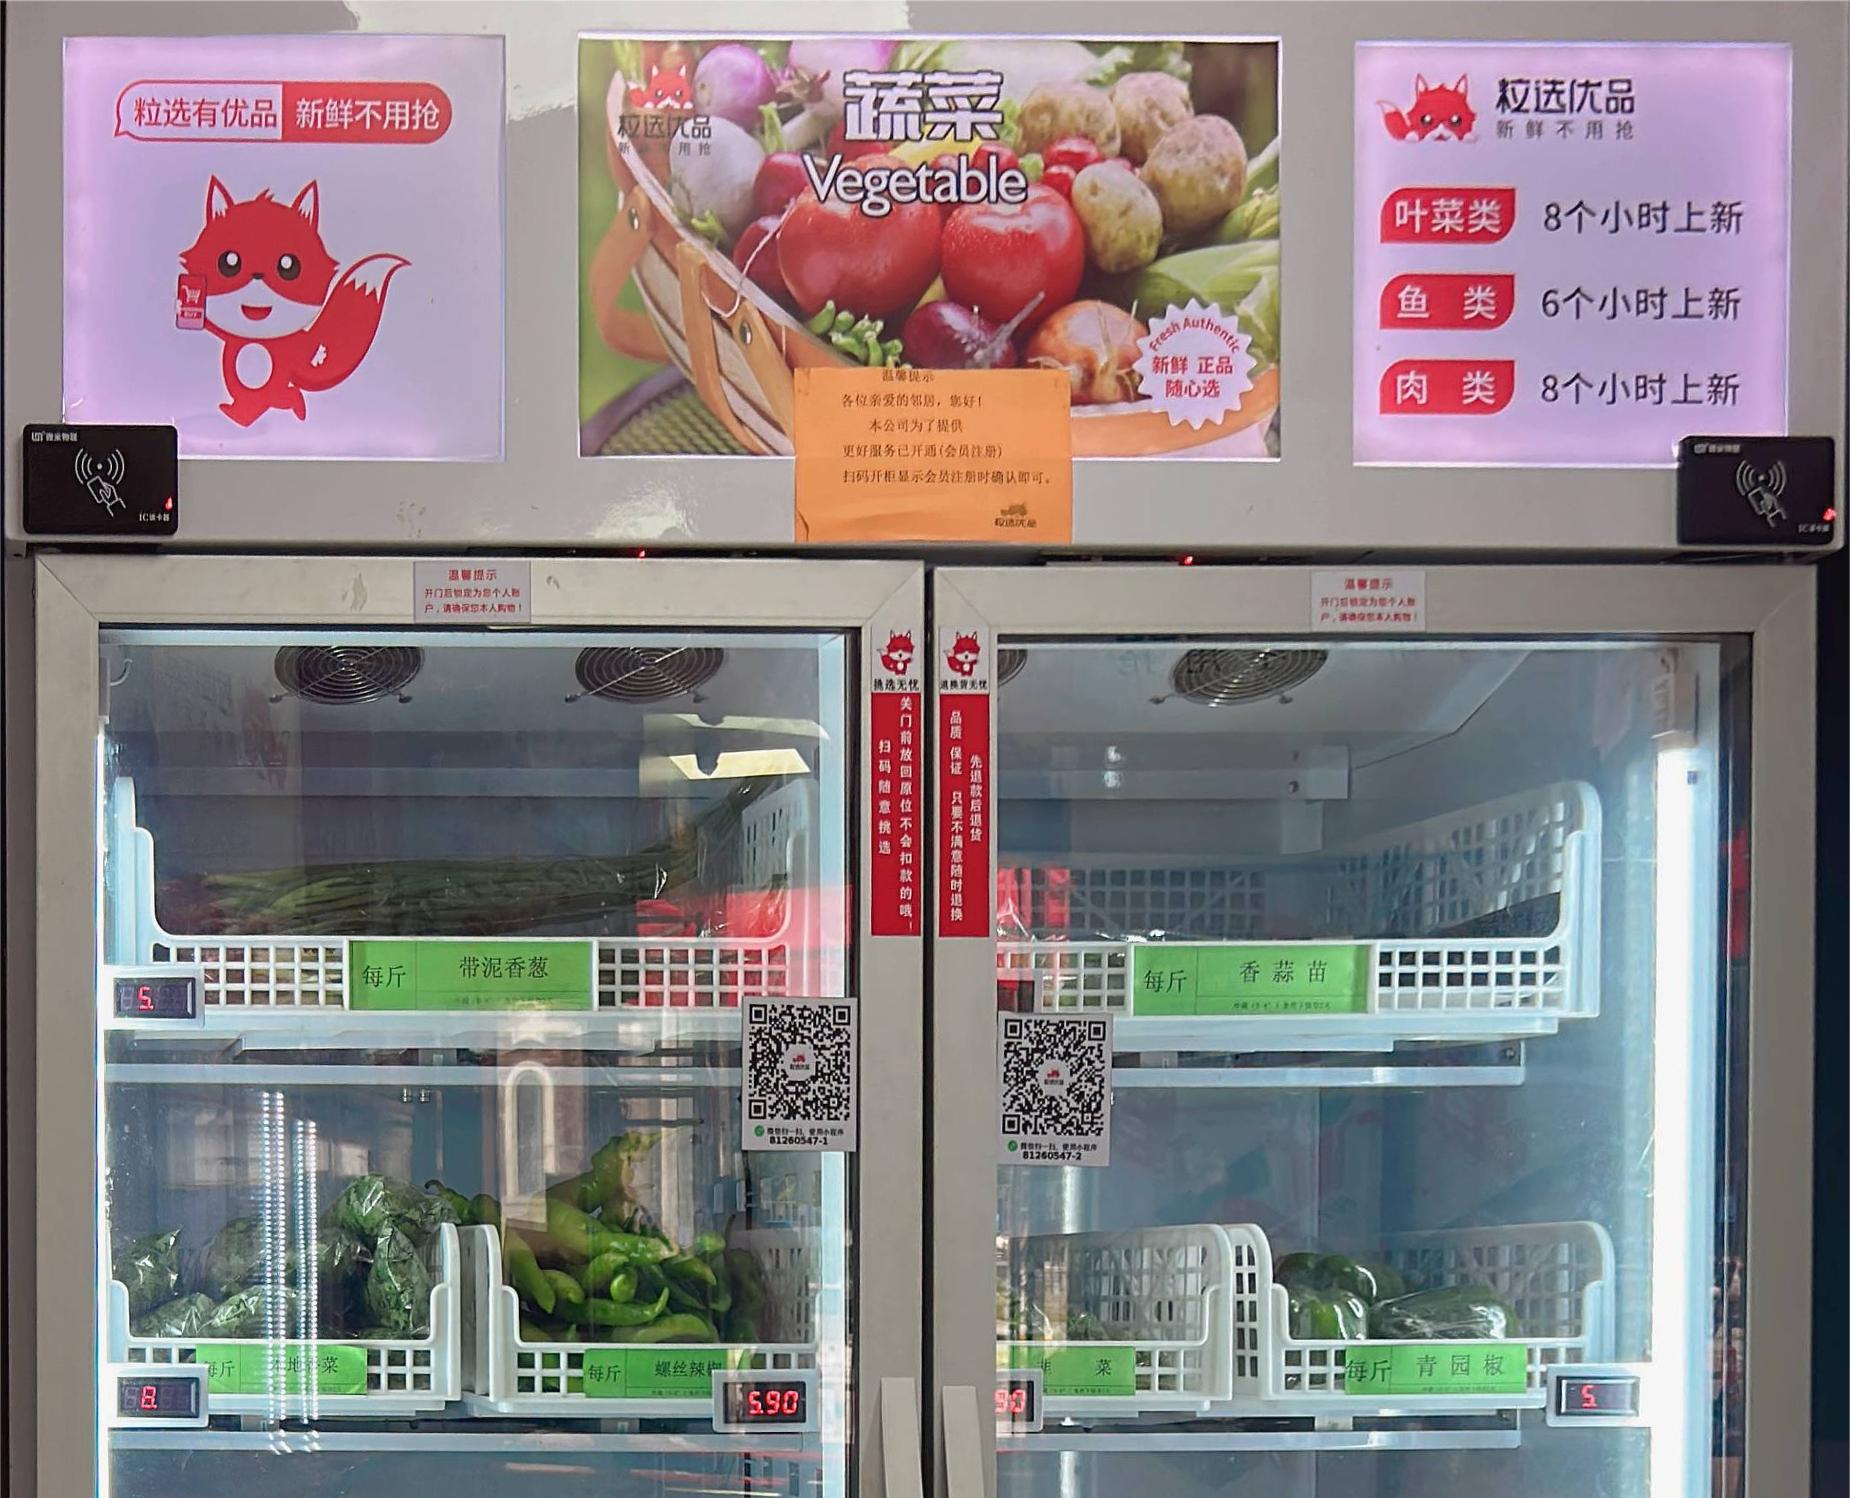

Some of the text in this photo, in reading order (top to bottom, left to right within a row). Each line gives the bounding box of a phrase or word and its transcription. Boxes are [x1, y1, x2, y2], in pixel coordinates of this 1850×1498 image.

[843, 70, 1004, 142] 蔬菜
[1496, 78, 1636, 116] 粒选优品
[134, 98, 440, 130] 粒选有优品 新鲜不用抢
[1496, 121, 1635, 141] 新鲜不用抢
[801, 152, 1028, 219] Vegetable
[1394, 199, 1745, 236] 叶菜类 8个小时上新
[1541, 287, 1742, 322] 6个小时上新
[1149, 317, 1240, 354] Fresh Authentic
[1152, 356, 1233, 375] 新鲜 正品
[1165, 379, 1220, 398] 随心选
[1541, 373, 1740, 408] 8个小时上新
[874, 679, 919, 691] 挑选无忧
[879, 739, 891, 854] 扫码随意挑选
[970, 754, 982, 842] 先退款后退货
[363, 956, 548, 988] 每斤 带泥香葱
[1144, 961, 1327, 993] 每斤 香蒜苗
[770, 1136, 828, 1145] 81260547-1
[1023, 1151, 1082, 1160] 81260547-2
[588, 1364, 622, 1384] 每斤
[1346, 1354, 1504, 1383] 每斤 青园椒
